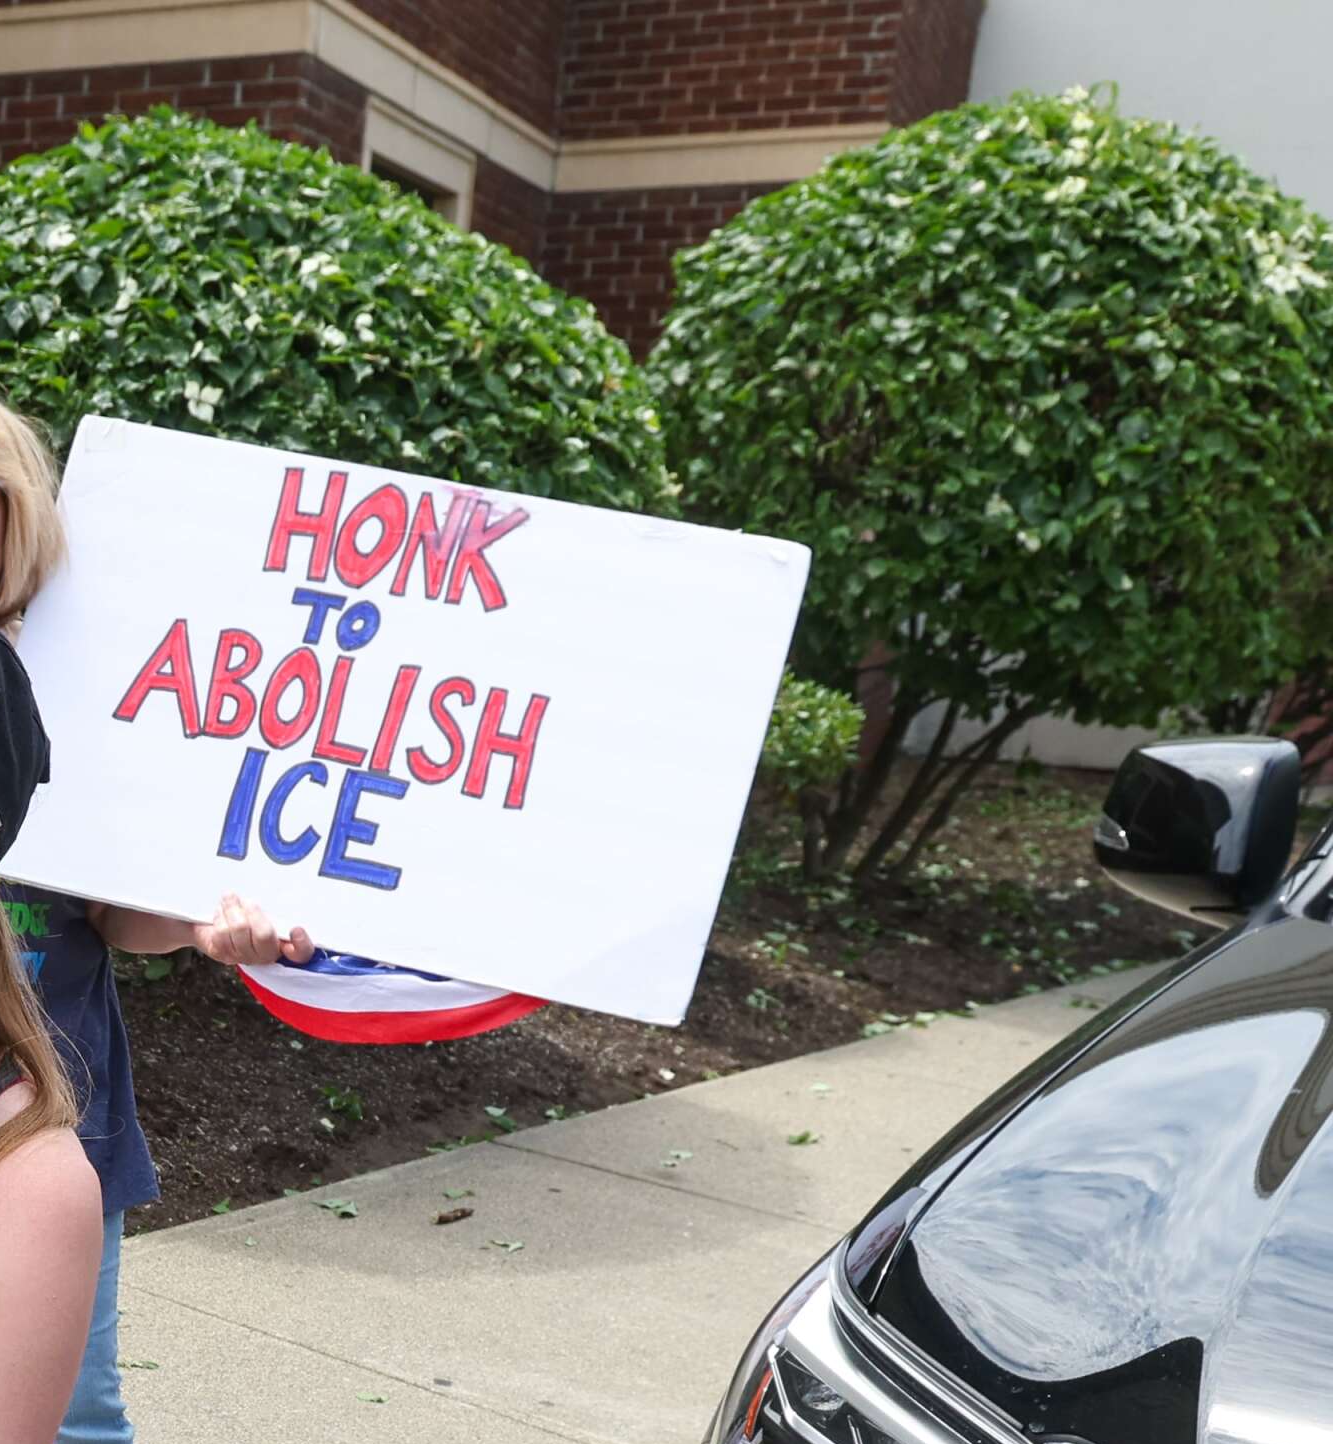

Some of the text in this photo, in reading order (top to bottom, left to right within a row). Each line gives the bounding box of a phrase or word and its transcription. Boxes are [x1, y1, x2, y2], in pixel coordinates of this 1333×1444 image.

[263, 466, 530, 612] HONK
[291, 588, 381, 652] TO
[111, 618, 550, 810] ABOLISH
[216, 748, 410, 890] ICE
